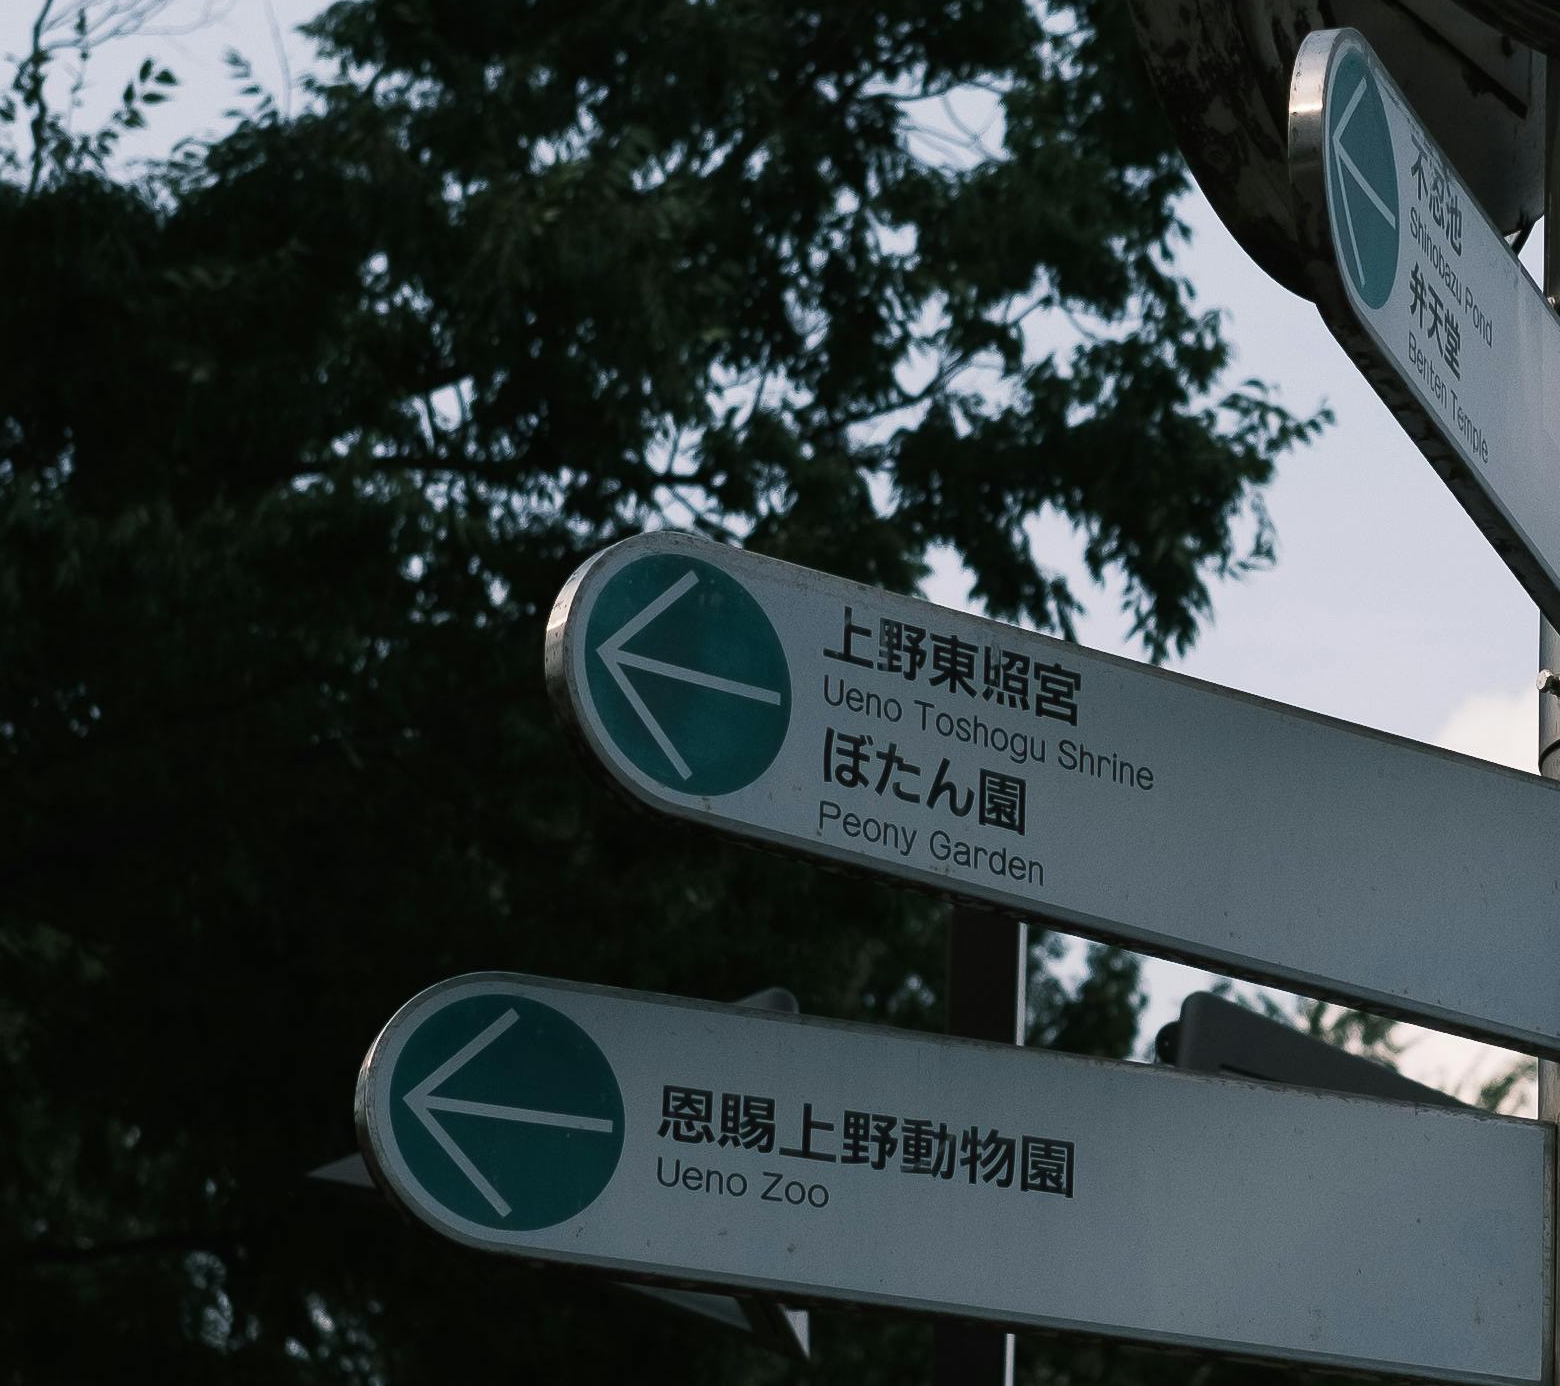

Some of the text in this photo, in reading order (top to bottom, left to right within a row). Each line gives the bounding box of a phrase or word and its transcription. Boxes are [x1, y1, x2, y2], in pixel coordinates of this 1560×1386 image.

[1410, 131, 1463, 257] 不忍池
[1409, 206, 1493, 348] Shinobazu Pond
[1410, 261, 1461, 381] 弁天堂
[1408, 331, 1488, 464] Benten Temple
[823, 606, 1081, 727] 上野東照宮
[823, 674, 1154, 790] Ueno Toshogu Shrine
[823, 727, 1026, 836] ぼたん園
[819, 800, 1044, 886] Peony Garden
[656, 1156, 829, 1208] Ueno Zoo
[657, 1084, 1075, 1198] 恩賜上野動物園
